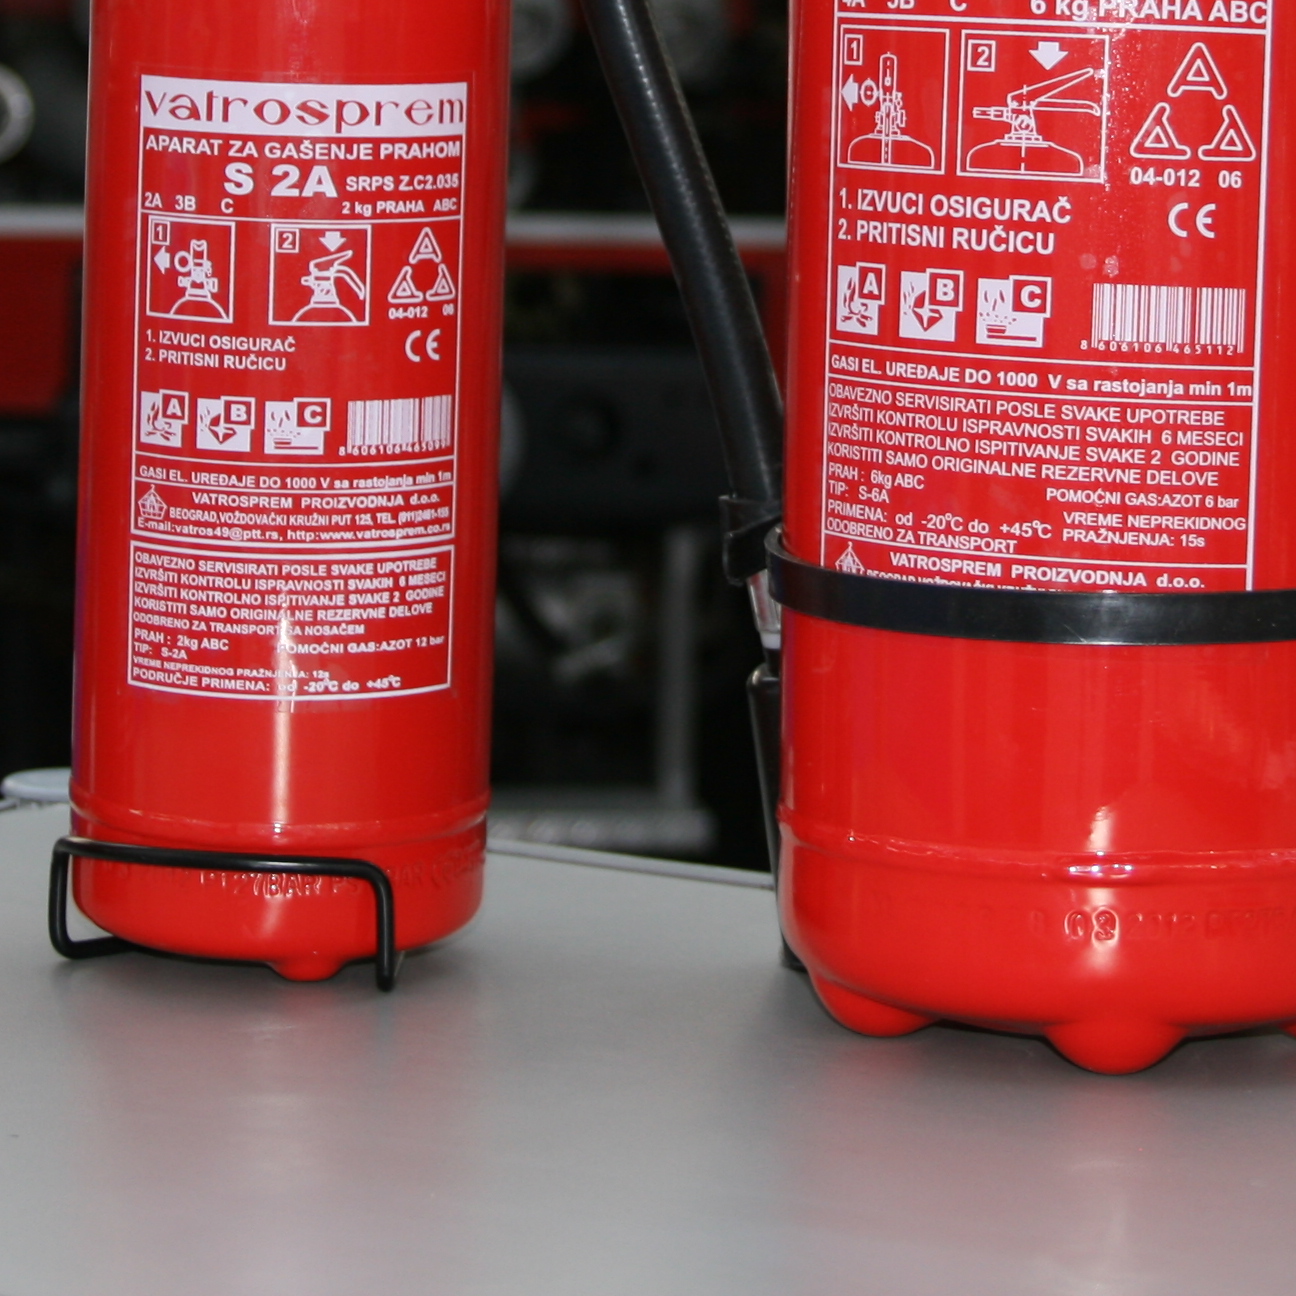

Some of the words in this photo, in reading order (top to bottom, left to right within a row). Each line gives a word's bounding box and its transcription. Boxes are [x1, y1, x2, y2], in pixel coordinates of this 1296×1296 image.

[1208, 0, 1267, 24] ABC
[145, 90, 464, 133] vatrosprem
[145, 135, 222, 154] APARAT
[228, 140, 258, 157] ZA
[264, 140, 373, 160] GAŠENJE
[379, 141, 460, 158] PRAHOM
[224, 163, 254, 195] S
[271, 165, 337, 197] 2A
[346, 176, 394, 191] SRPS
[1130, 167, 1200, 188] 04-012
[1218, 170, 1242, 189] 06
[145, 192, 162, 207] 2A
[175, 195, 195, 211] 3B
[220, 198, 234, 213] C
[342, 202, 350, 214] 2
[354, 201, 372, 216] kg
[376, 199, 424, 213] PRAHA
[433, 198, 457, 211] ABC
[839, 188, 853, 210] 1.
[856, 189, 924, 216] IZVUCI
[930, 193, 1072, 224] OSIGURAČ
[838, 218, 852, 240] 2.
[856, 222, 945, 249] PRITISNI
[952, 224, 1054, 255] RUČICU
[862, 273, 878, 294] A
[936, 279, 954, 300] B
[1020, 285, 1042, 307] C
[145, 329, 156, 342] 1.
[159, 331, 205, 348] IZVUCI
[209, 334, 296, 352] OSIGURAČ
[145, 348, 156, 361] 2.
[159, 352, 219, 368] PRITISNI
[224, 353, 286, 371] RUČICU
[831, 354, 859, 372] GASI
[886, 361, 959, 383] UREĐAJE
[965, 367, 991, 385] DO
[997, 371, 1038, 388] 1000
[1048, 373, 1061, 389] V
[1066, 377, 1088, 390] sa
[1093, 377, 1184, 399] rastojanja
[1189, 379, 1221, 396] min
[1226, 381, 1252, 396] 1m
[166, 398, 182, 417] A
[230, 404, 246, 421] B
[303, 405, 322, 424] C
[829, 384, 891, 405] OBAVEZNO
[895, 391, 991, 414] SERVISIRATI
[996, 400, 1055, 419] POSLE
[1060, 405, 1120, 422] SVAKE
[1126, 408, 1225, 426] UPOTREBE
[829, 402, 873, 423] IZVRŠITI
[876, 408, 958, 433] KONTROLU
[962, 418, 1080, 441] ISPRAVNOSTI
[1085, 426, 1152, 444] SVAKIH
[1161, 429, 1171, 444] 6
[1176, 430, 1243, 446] MESECI
[828, 421, 873, 443] IZVRŠITI
[875, 429, 970, 453] KONTROLNO
[974, 438, 1080, 460] ISPITIVANJE
[1085, 445, 1146, 463] SVAKE
[1150, 449, 1160, 465] 2
[1171, 450, 1240, 467] GODINE
[827, 441, 883, 462] KORISTITI
[886, 450, 927, 469] SAMO
[931, 456, 1036, 479] ORIGINALNE
[1041, 464, 1141, 483] REZERVNE
[1146, 468, 1219, 486] DELOVE
[871, 468, 892, 487] 6kg
[894, 473, 925, 489] ABC
[192, 492, 293, 509] VATROSPREM
[301, 495, 404, 508] PROIZVODNJA
[858, 486, 890, 504] S-6A
[1205, 493, 1214, 508] 6
[1218, 495, 1239, 509] bar
[895, 511, 913, 525] od
[968, 518, 989, 534] do
[1063, 512, 1123, 528] VREME
[1127, 513, 1246, 531] NEPREKIDNOG
[827, 517, 894, 540] ODOBRENO
[896, 529, 916, 543] ZA
[918, 529, 1018, 553] TRANSPORT
[1180, 533, 1205, 547] 15s
[889, 552, 1002, 576] VATROSPREM
[1011, 564, 1147, 588] PROIZVODNJA
